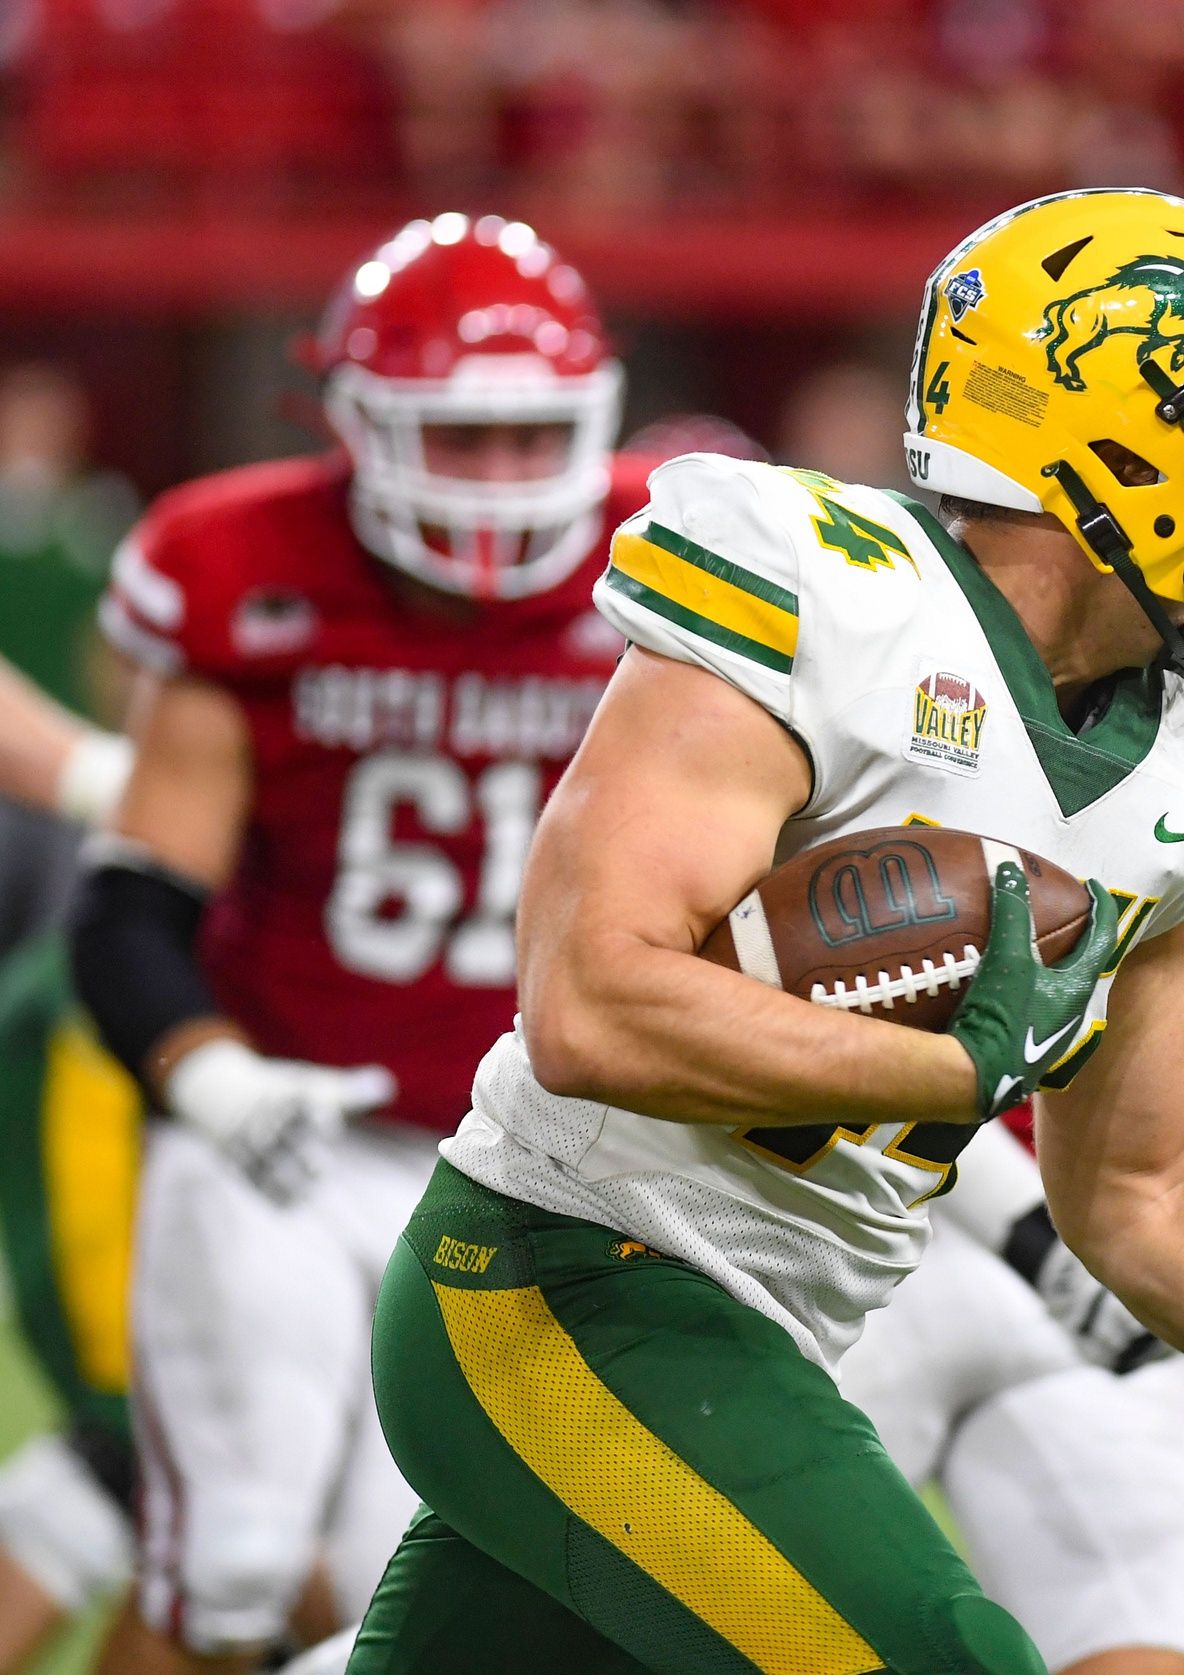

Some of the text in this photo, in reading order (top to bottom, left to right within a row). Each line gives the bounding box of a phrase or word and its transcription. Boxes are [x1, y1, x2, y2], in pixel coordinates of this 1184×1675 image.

[949, 281, 978, 302] FCS
[926, 361, 951, 415] 4
[998, 365, 1027, 384] WARNING
[907, 447, 931, 481] SU
[915, 690, 986, 749] VALLEY
[910, 746, 943, 759] FOOTBALL
[911, 736, 980, 760] MISSOURI VALLEY
[325, 748, 541, 987] 61
[432, 1234, 498, 1274] BISON
